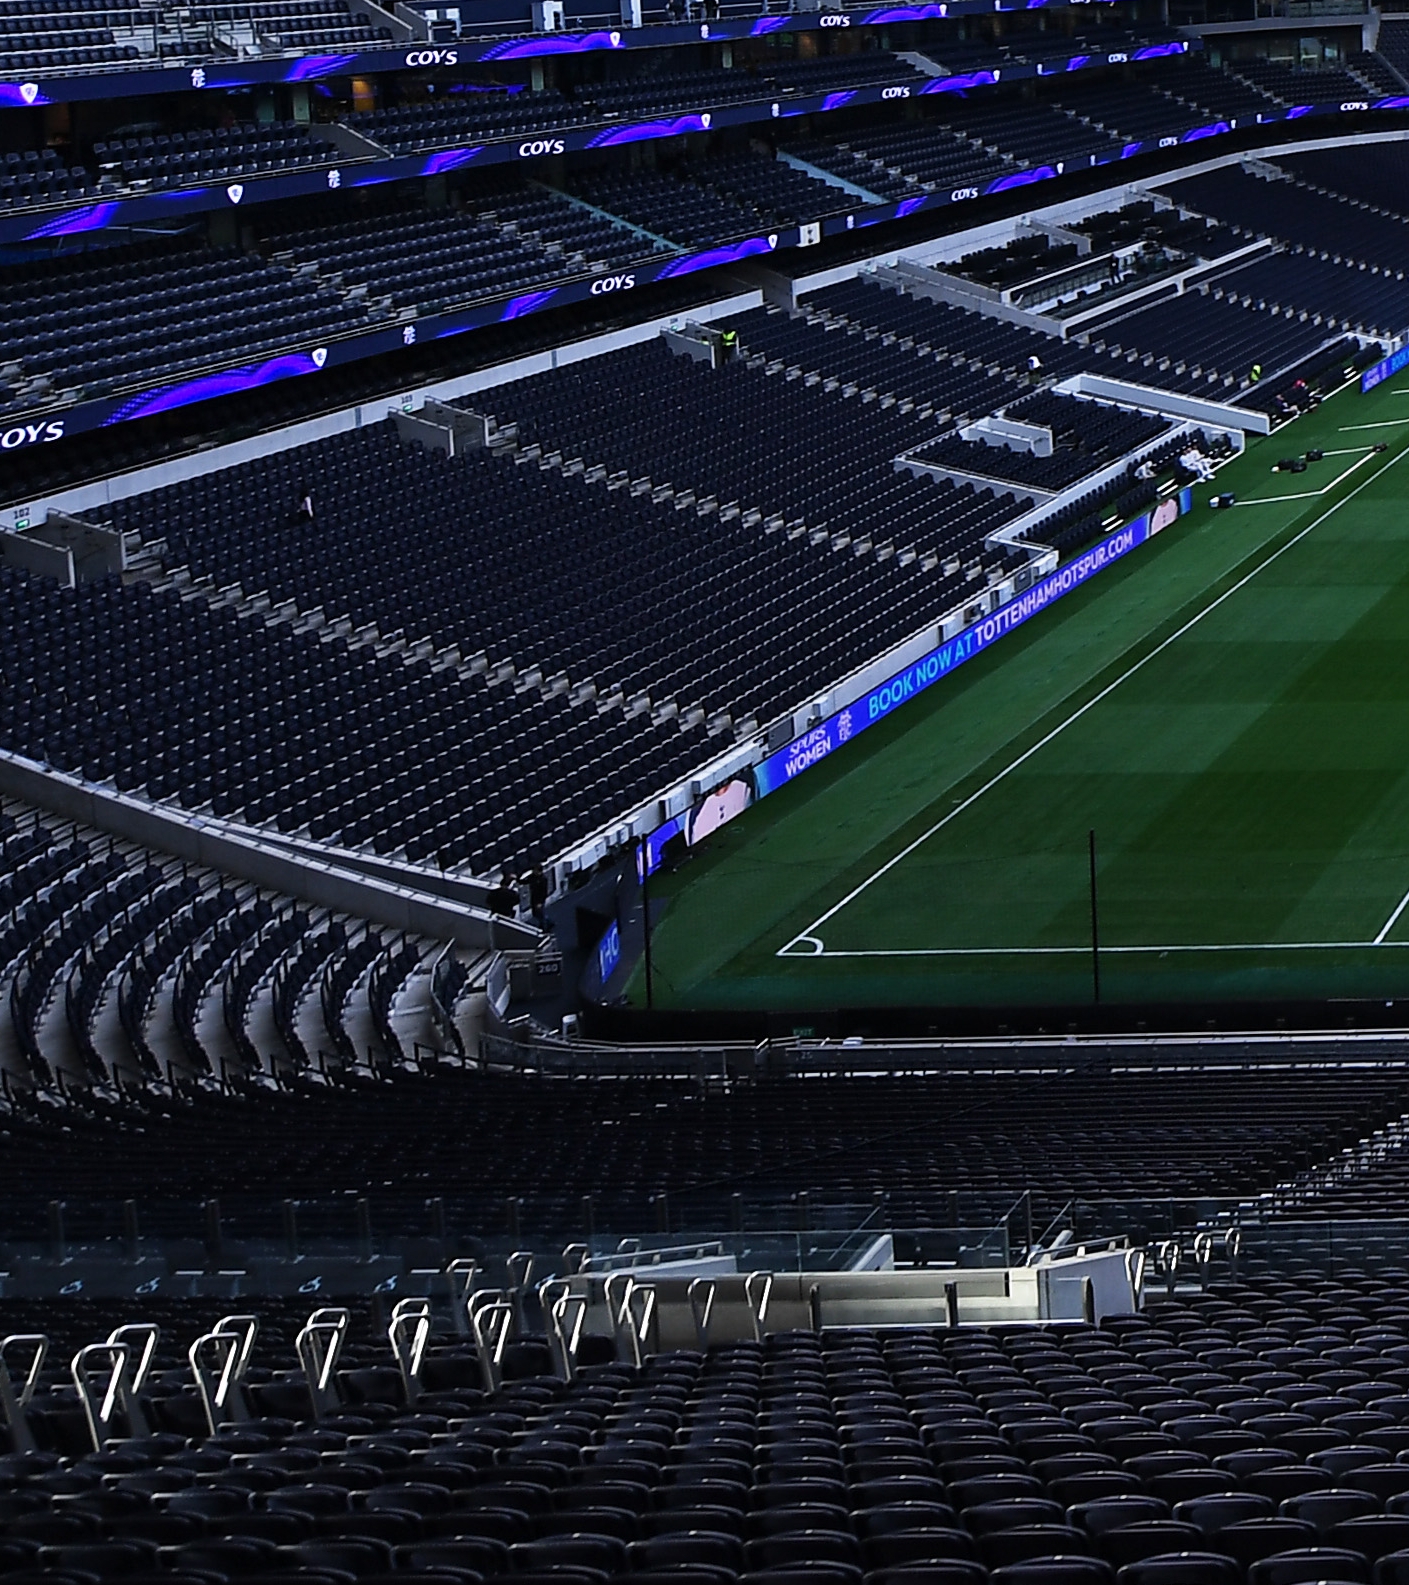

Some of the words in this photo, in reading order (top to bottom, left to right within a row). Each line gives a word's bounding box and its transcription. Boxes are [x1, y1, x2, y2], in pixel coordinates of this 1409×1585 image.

[406, 50, 457, 66] COYS
[519, 140, 565, 157] COYS
[591, 274, 635, 294] COYS
[0, 421, 64, 449] OYS
[13, 507, 30, 520] 102
[868, 670, 914, 719] BOOK
[916, 645, 952, 687] NOW
[954, 631, 974, 662] AT
[974, 528, 1133, 646] TOTTENHAMHOTSPUR.COM
[785, 736, 831, 777] WOMEN
